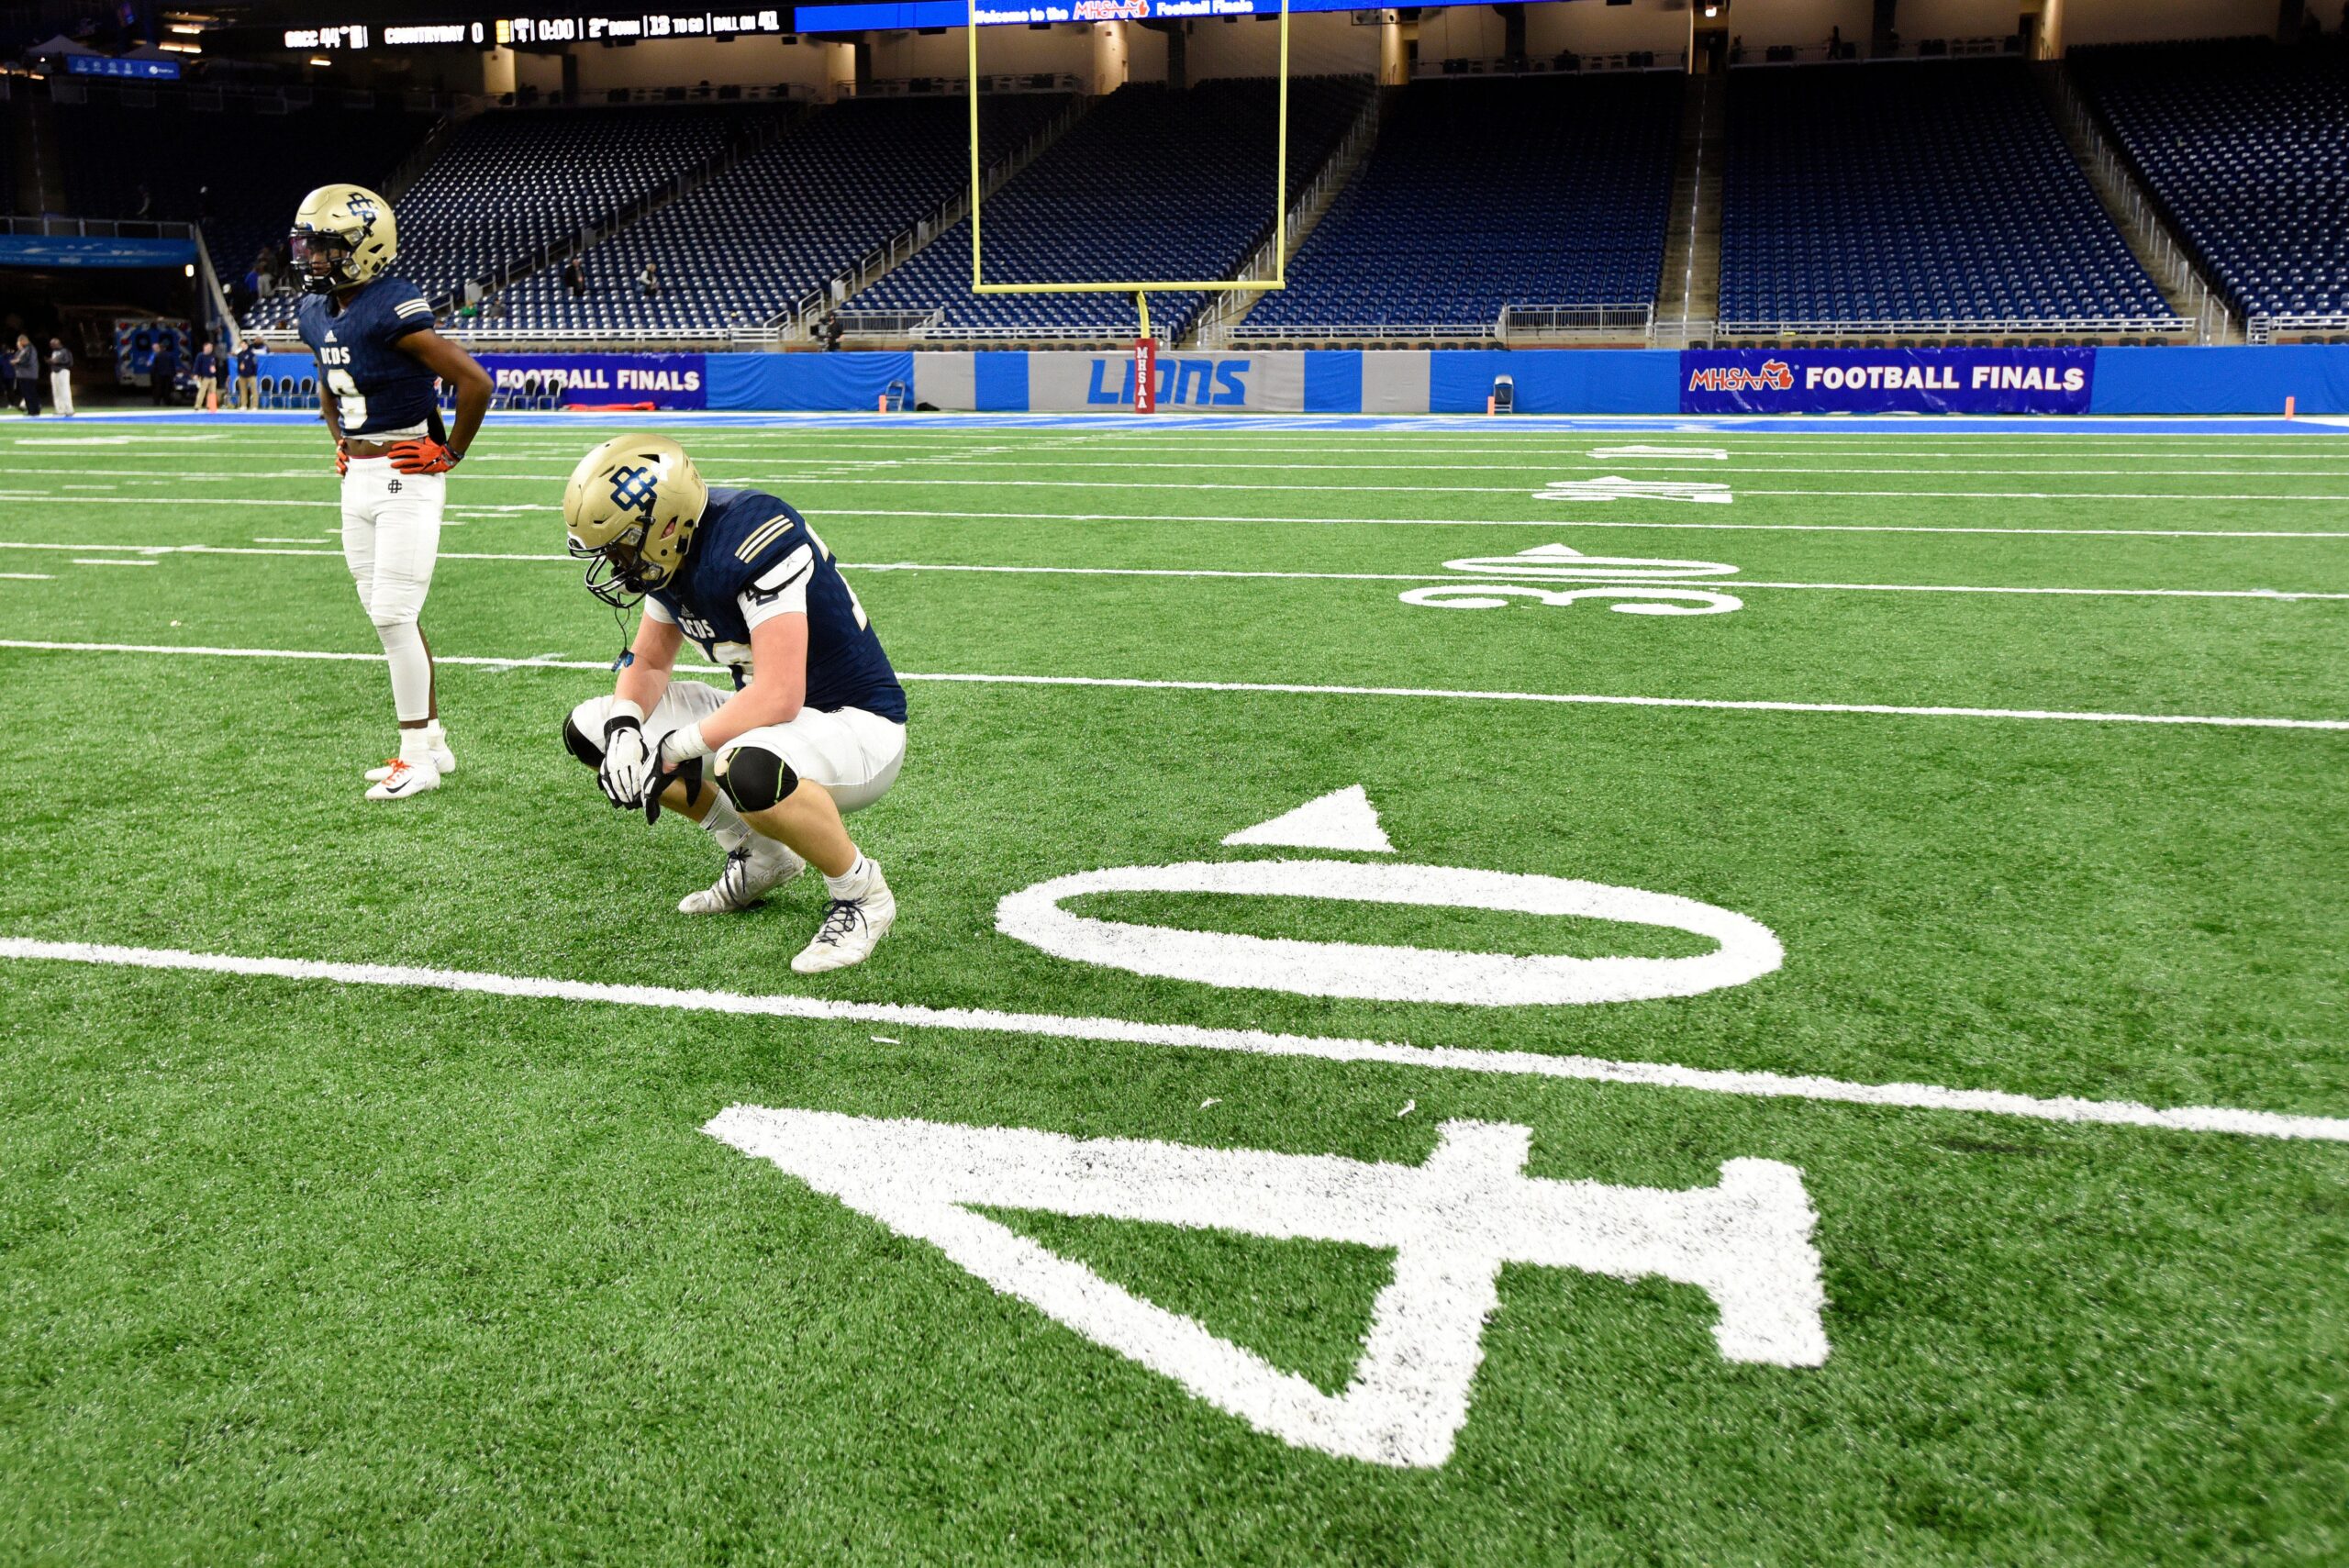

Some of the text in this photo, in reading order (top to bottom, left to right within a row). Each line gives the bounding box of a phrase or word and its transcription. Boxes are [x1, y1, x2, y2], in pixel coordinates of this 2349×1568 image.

[1030, 8, 1045, 21] to
[1046, 7, 1069, 20] the
[1157, 1, 1209, 16] Football
[1212, 0, 1253, 13] Finals
[539, 19, 574, 40] 0:00
[650, 16, 671, 36] 13
[495, 369, 700, 392] FOOTBALL FINALS
[1086, 359, 1251, 406] LIONS
[1688, 365, 2085, 393] MHSAA FOOTBALL FINALS
